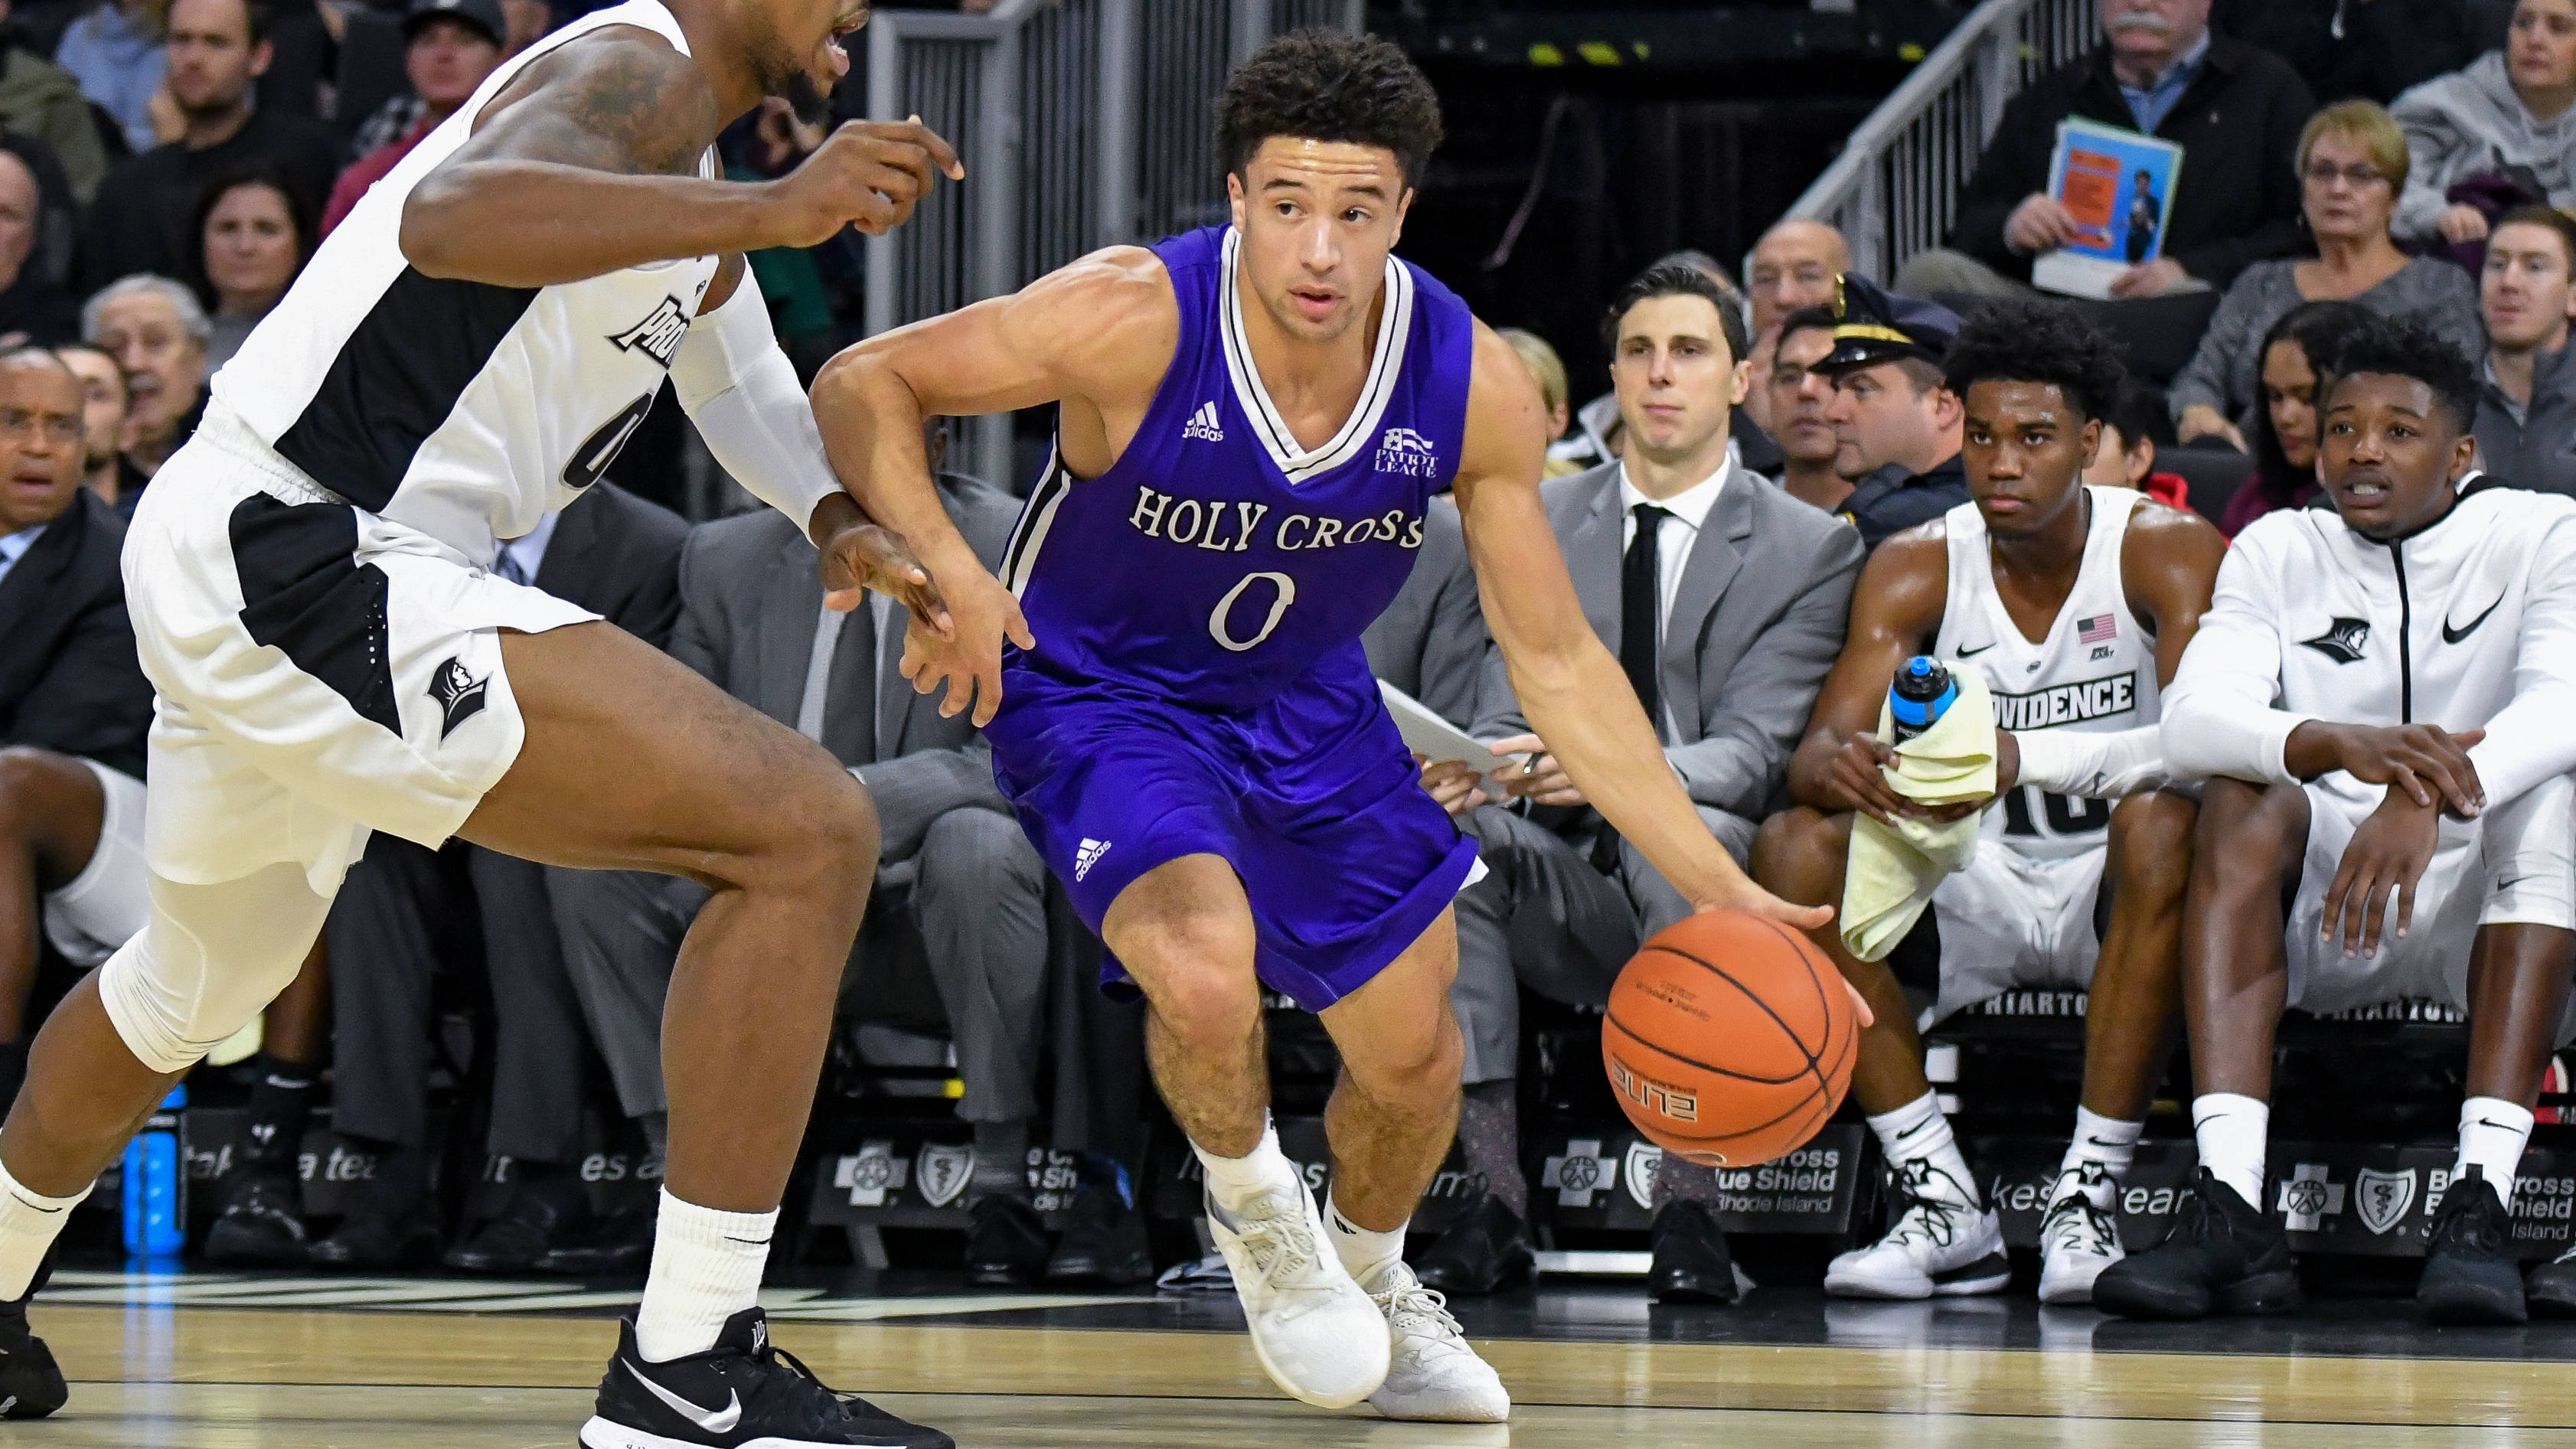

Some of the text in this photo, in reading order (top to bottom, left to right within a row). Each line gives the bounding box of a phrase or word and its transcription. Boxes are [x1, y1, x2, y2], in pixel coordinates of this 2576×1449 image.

[1182, 424, 1224, 442] adidas
[1128, 485, 1424, 552] HOLY CROSS
[1209, 571, 1296, 652] 0
[1076, 840, 1112, 883] adidas
[1755, 1167, 1837, 1192] Shield
[2514, 1175, 2575, 1196] ross
[1776, 1194, 1833, 1213] Island
[2508, 1195, 2573, 1219] hield
[2511, 1222, 2569, 1240] Island
